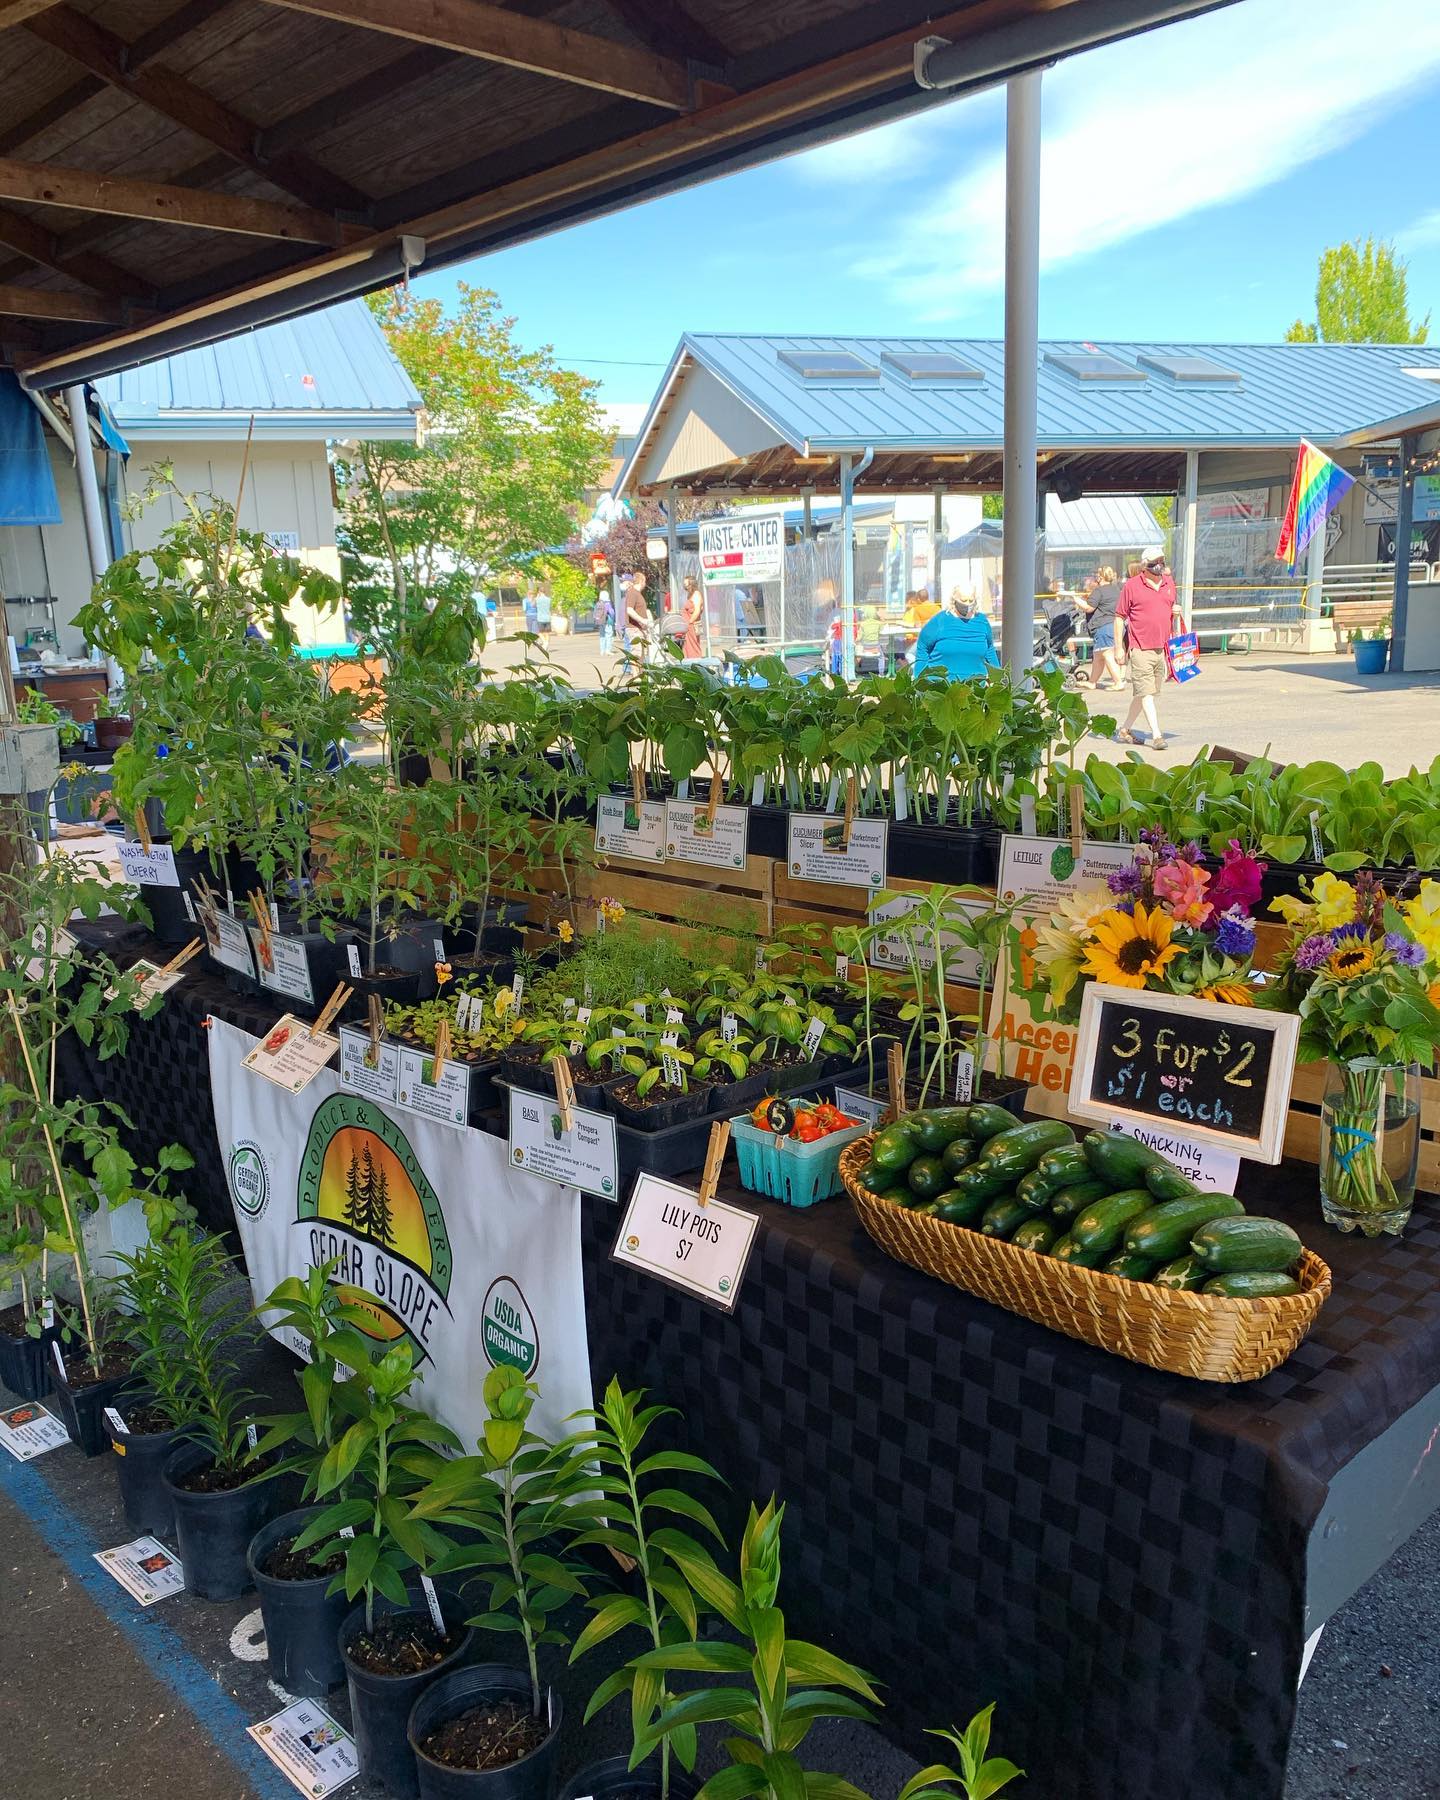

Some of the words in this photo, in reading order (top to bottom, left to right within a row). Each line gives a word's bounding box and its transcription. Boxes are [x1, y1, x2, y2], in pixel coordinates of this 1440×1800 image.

[703, 527, 734, 552] WASTE
[741, 520, 778, 548] CENTER
[793, 827, 822, 839] CUCUMBER
[800, 839, 815, 849] Slicer
[127, 864, 158, 882] CHERRY
[1013, 851, 1042, 864] LETTUCE
[1112, 1018, 1140, 1058] 3
[1160, 1074, 1193, 1092] or
[522, 1107, 539, 1122] BASIL
[1158, 1092, 1233, 1126] each
[1131, 1128, 1202, 1165] SNACKING
[303, 1103, 349, 1205] PRODUCE
[356, 1106, 370, 1125] &
[381, 1119, 448, 1278] FLOWERS
[661, 1204, 692, 1230] LILY
[689, 1216, 722, 1244] POTS
[675, 1239, 693, 1261] $7
[310, 1229, 363, 1291] CEDAR
[375, 1255, 439, 1345] SLOPE
[494, 1297, 522, 1334] USDA
[487, 1323, 528, 1361] ORGANIC
